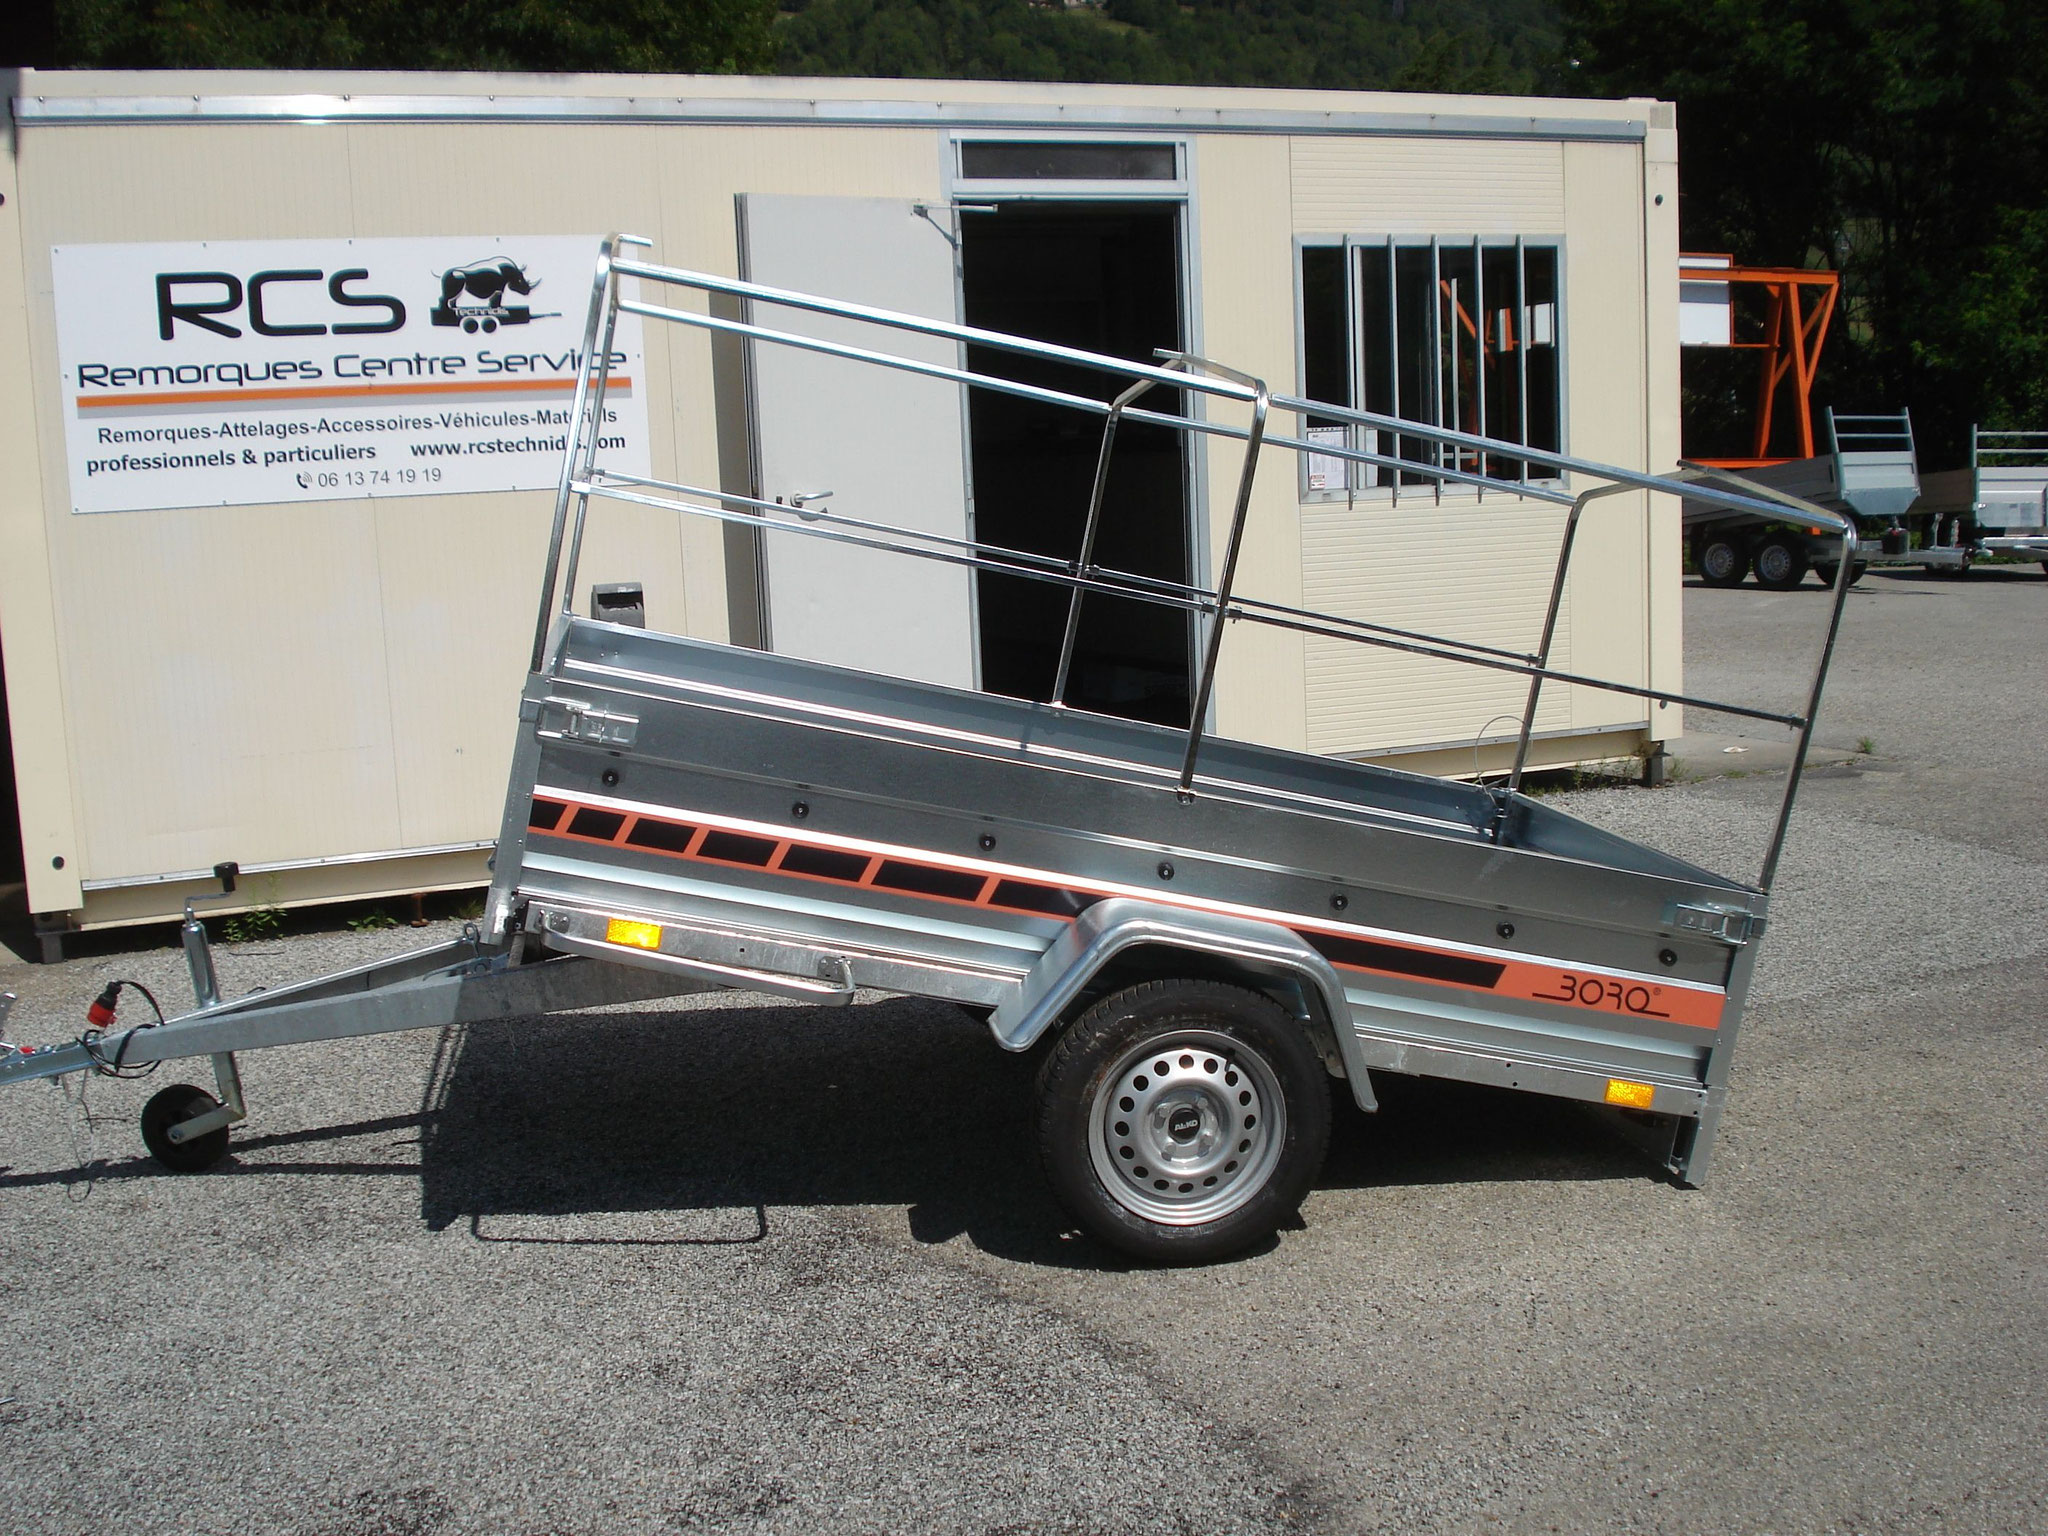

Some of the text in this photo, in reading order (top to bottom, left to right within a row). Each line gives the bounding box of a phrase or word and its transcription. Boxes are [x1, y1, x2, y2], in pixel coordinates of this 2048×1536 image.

[155, 267, 406, 341] RCS
[77, 348, 627, 388] Remorques Centre Service
[98, 407, 618, 444] Remorques-Attelages-Accessoires-Véhicules-Matrils
[86, 435, 626, 476] professionnels & particuliers www.rcstechnids.om
[317, 467, 441, 488] 06 13 74 19 19
